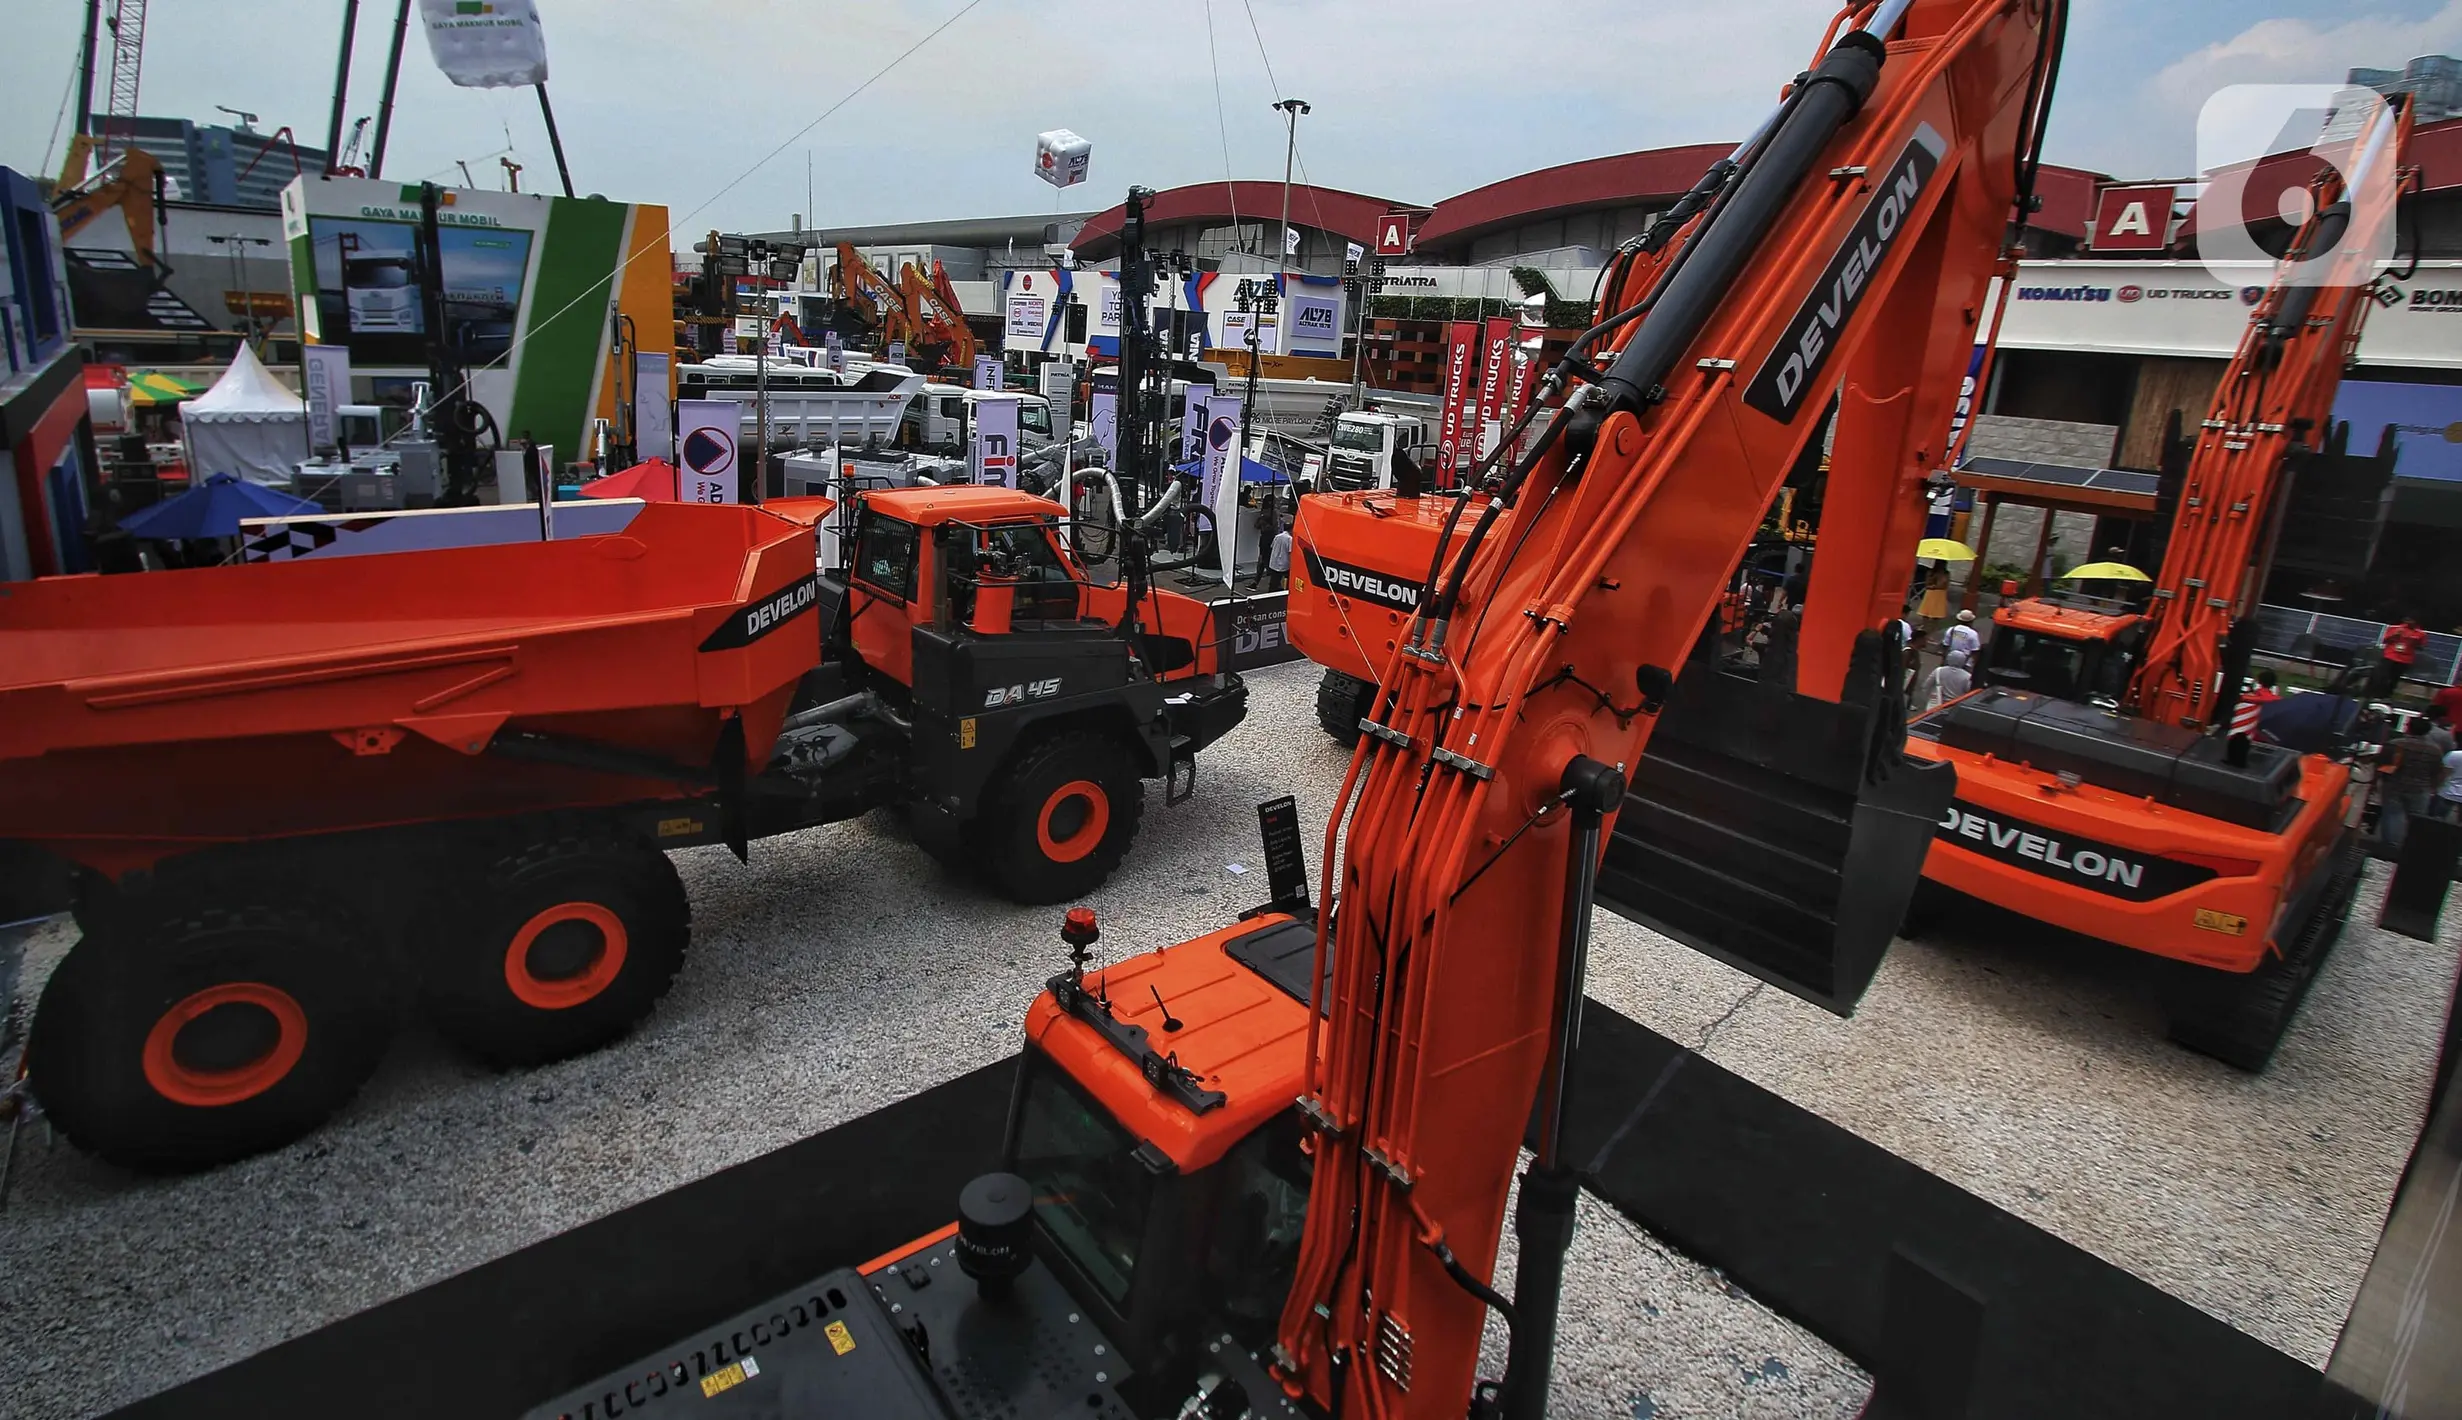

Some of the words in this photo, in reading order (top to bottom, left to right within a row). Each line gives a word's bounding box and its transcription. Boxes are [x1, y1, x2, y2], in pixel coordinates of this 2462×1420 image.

[432, 21, 455, 30] GAYA
[457, 20, 495, 28] MAKMUR
[497, 19, 524, 27] MOBIL
[361, 206, 396, 219] GAYA
[399, 209, 455, 224] MAUR
[459, 214, 501, 226] MOBIL
[2108, 202, 2151, 235] A
[1383, 225, 1400, 246] A
[1776, 159, 1919, 408] DEVELON
[2017, 284, 2111, 301] KOMATSU
[2147, 289, 2167, 299] UD
[2171, 289, 2232, 300] TRUCKS
[874, 284, 903, 313] CASE
[929, 298, 955, 327] CASE
[1449, 343, 1465, 409] TRUCKS
[1484, 339, 1504, 402] TRUCKS
[1446, 412, 1455, 435] UD
[1325, 566, 1417, 605] DEVELON
[748, 580, 816, 636] DEVELON
[985, 684, 1024, 708] DA
[1028, 677, 1062, 698] 45
[1264, 801, 1292, 813] DEVELON
